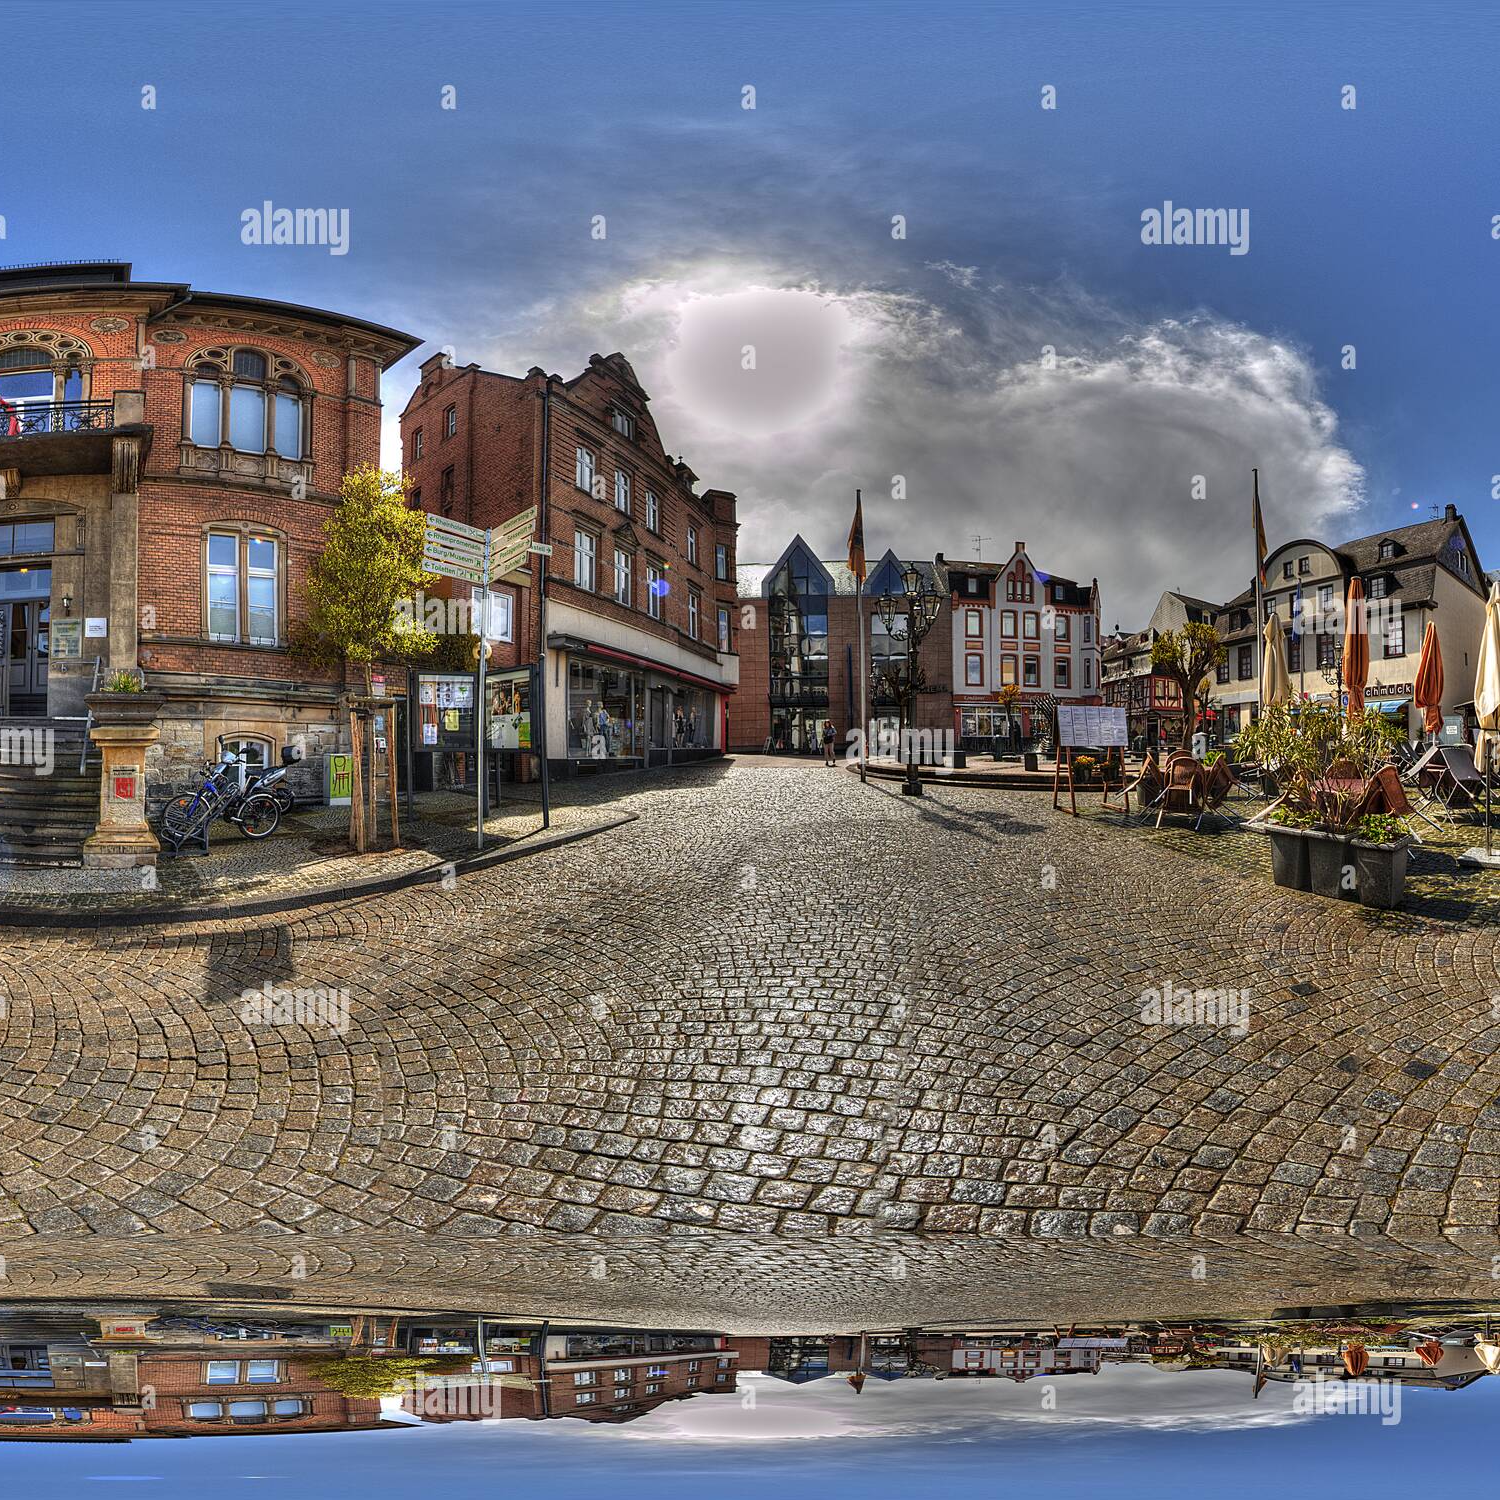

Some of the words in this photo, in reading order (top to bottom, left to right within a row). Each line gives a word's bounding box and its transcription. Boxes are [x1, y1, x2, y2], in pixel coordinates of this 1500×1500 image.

[435, 517, 467, 533] Rheinhotels
[433, 532, 481, 551] Rheinpromenade
[433, 547, 474, 564] Burg/Museum
[431, 563, 455, 575] Toiletten
[1365, 685, 1411, 697] chmuck
